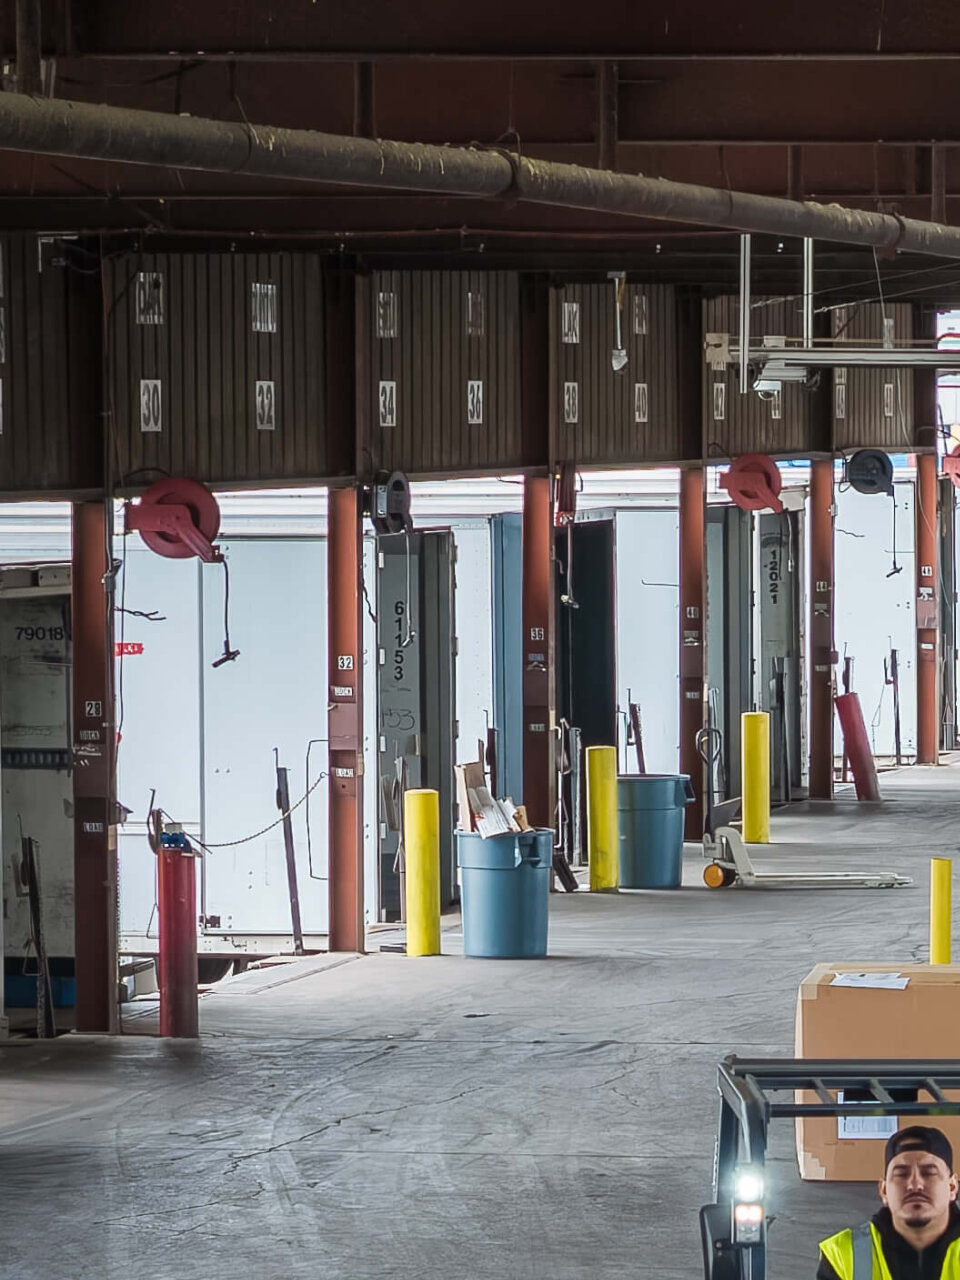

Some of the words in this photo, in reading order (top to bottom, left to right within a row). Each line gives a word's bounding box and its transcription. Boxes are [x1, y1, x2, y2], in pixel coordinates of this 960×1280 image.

[142, 384, 160, 427] 30
[257, 385, 274, 425] 32
[381, 386, 396, 424] 34
[469, 384, 482, 421] 36
[566, 386, 578, 419] 38
[636, 386, 647, 420] 40
[769, 549, 778, 604] 12021
[394, 600, 405, 680] 61153
[531, 628, 544, 640] 36
[339, 657, 352, 669] 32
